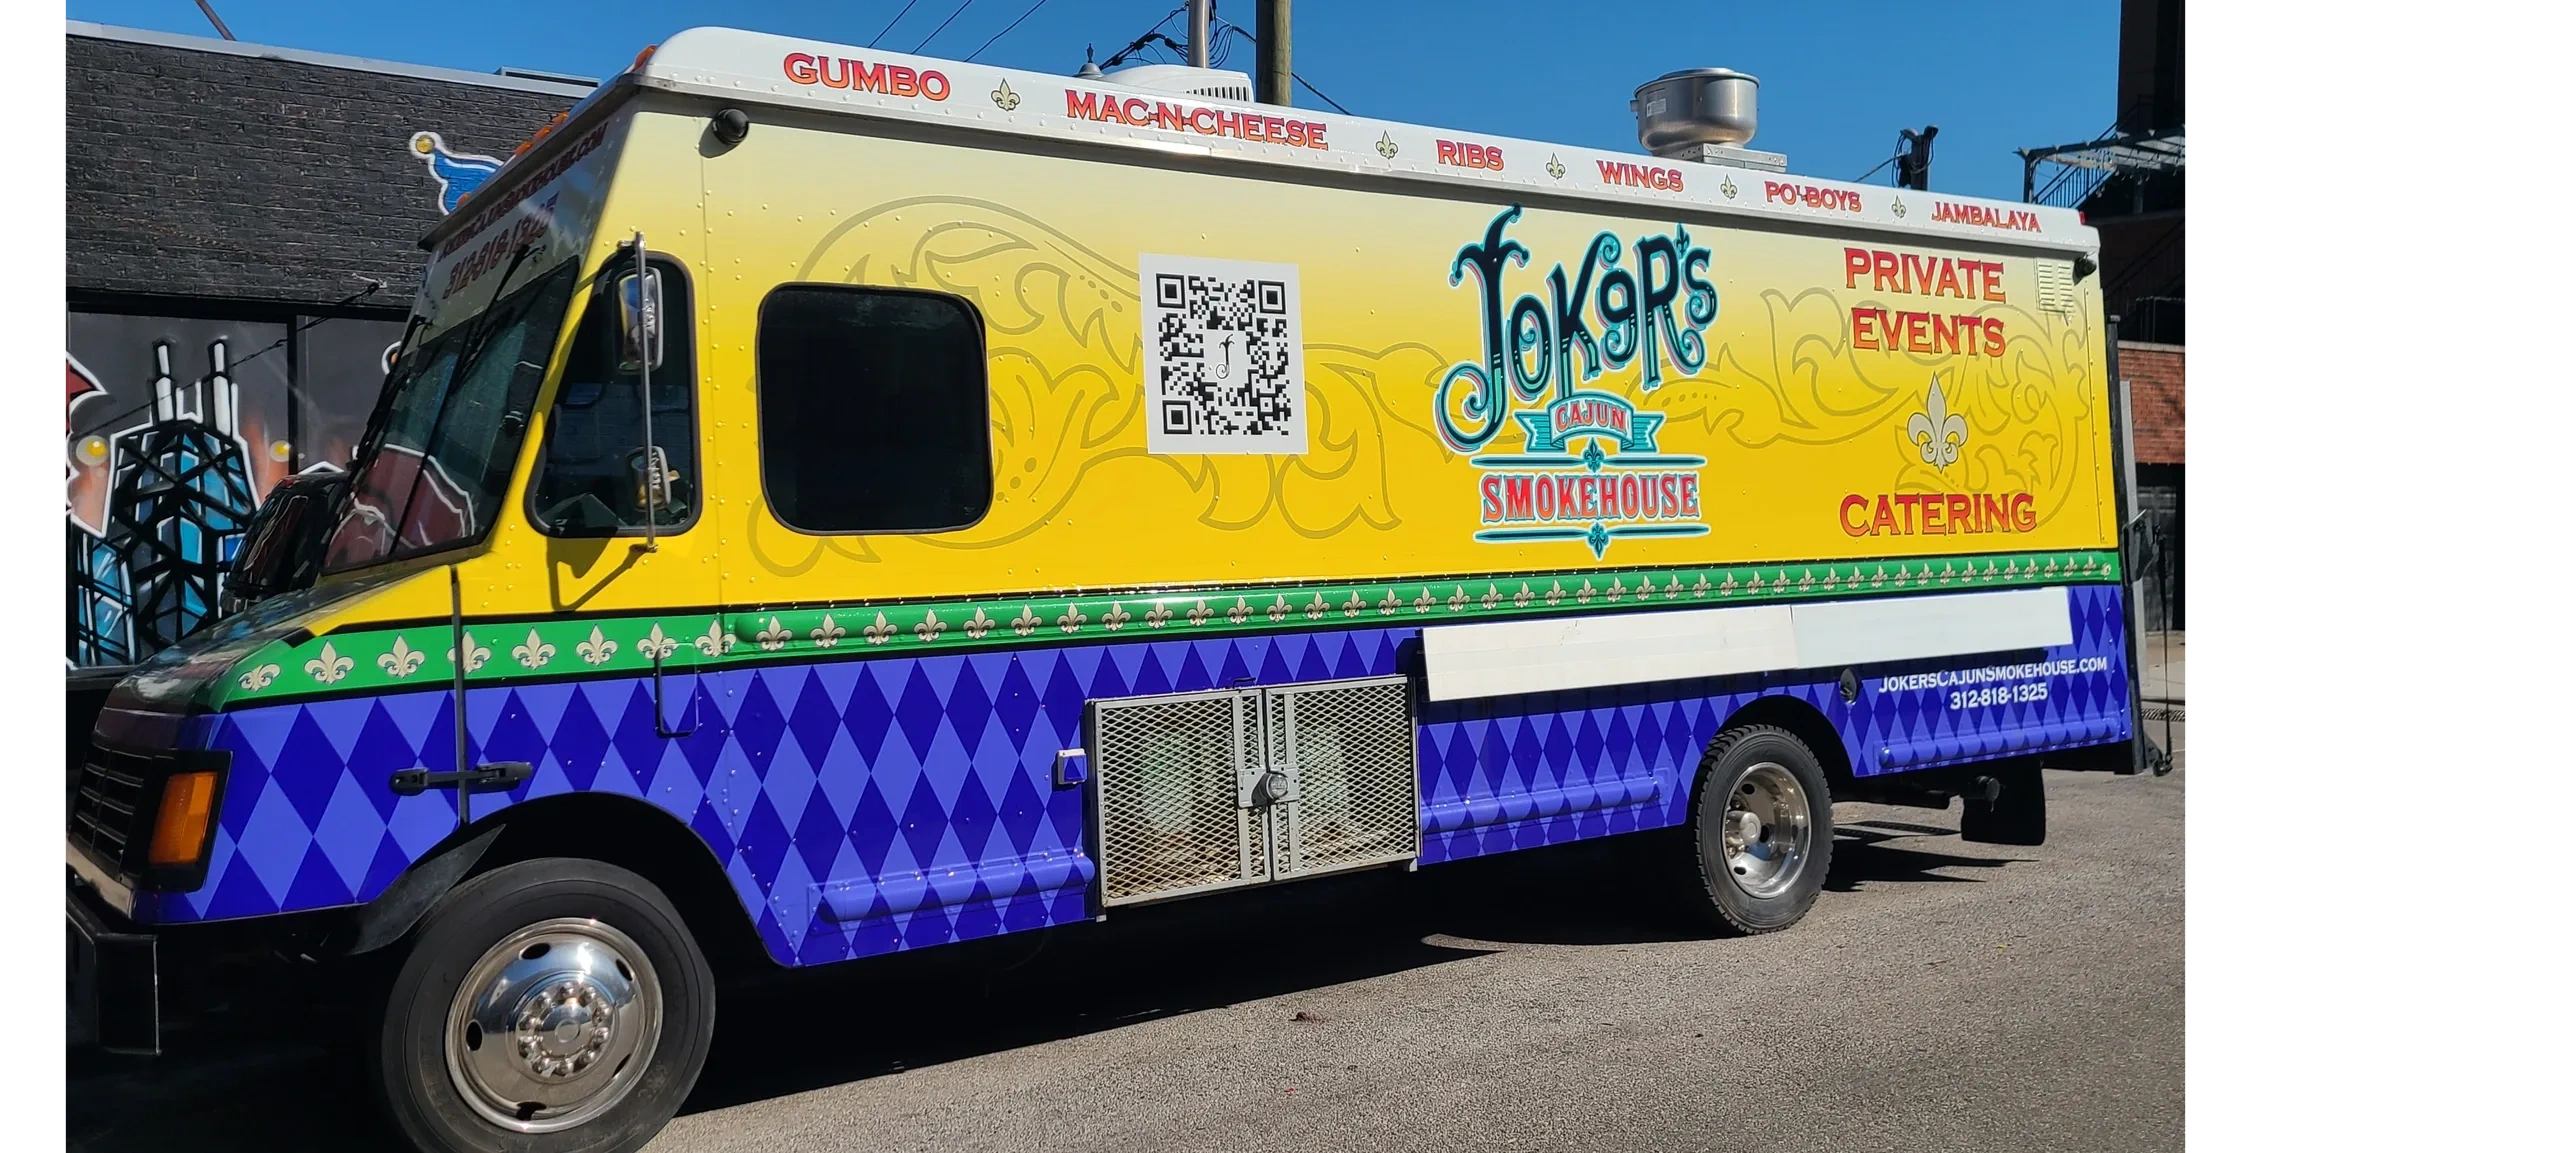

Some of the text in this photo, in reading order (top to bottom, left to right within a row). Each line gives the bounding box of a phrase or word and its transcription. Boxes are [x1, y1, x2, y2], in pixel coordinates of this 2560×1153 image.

[784, 53, 950, 101] GUMBO
[1066, 90, 1328, 150] MAC-N-CHEESE
[1436, 139, 1505, 173] RIBS
[1597, 159, 1684, 193] WINGS
[1931, 201, 2042, 233] JAMBALAYA
[1844, 248, 2006, 303] PRIVATE
[1851, 307, 2006, 358] EVENTS
[1554, 398, 1628, 434] CAJUN
[1480, 473, 1702, 524] SMOKEHOUSE
[1839, 492, 2037, 537] CATERING
[1950, 683, 2048, 710] 312-818-1325
